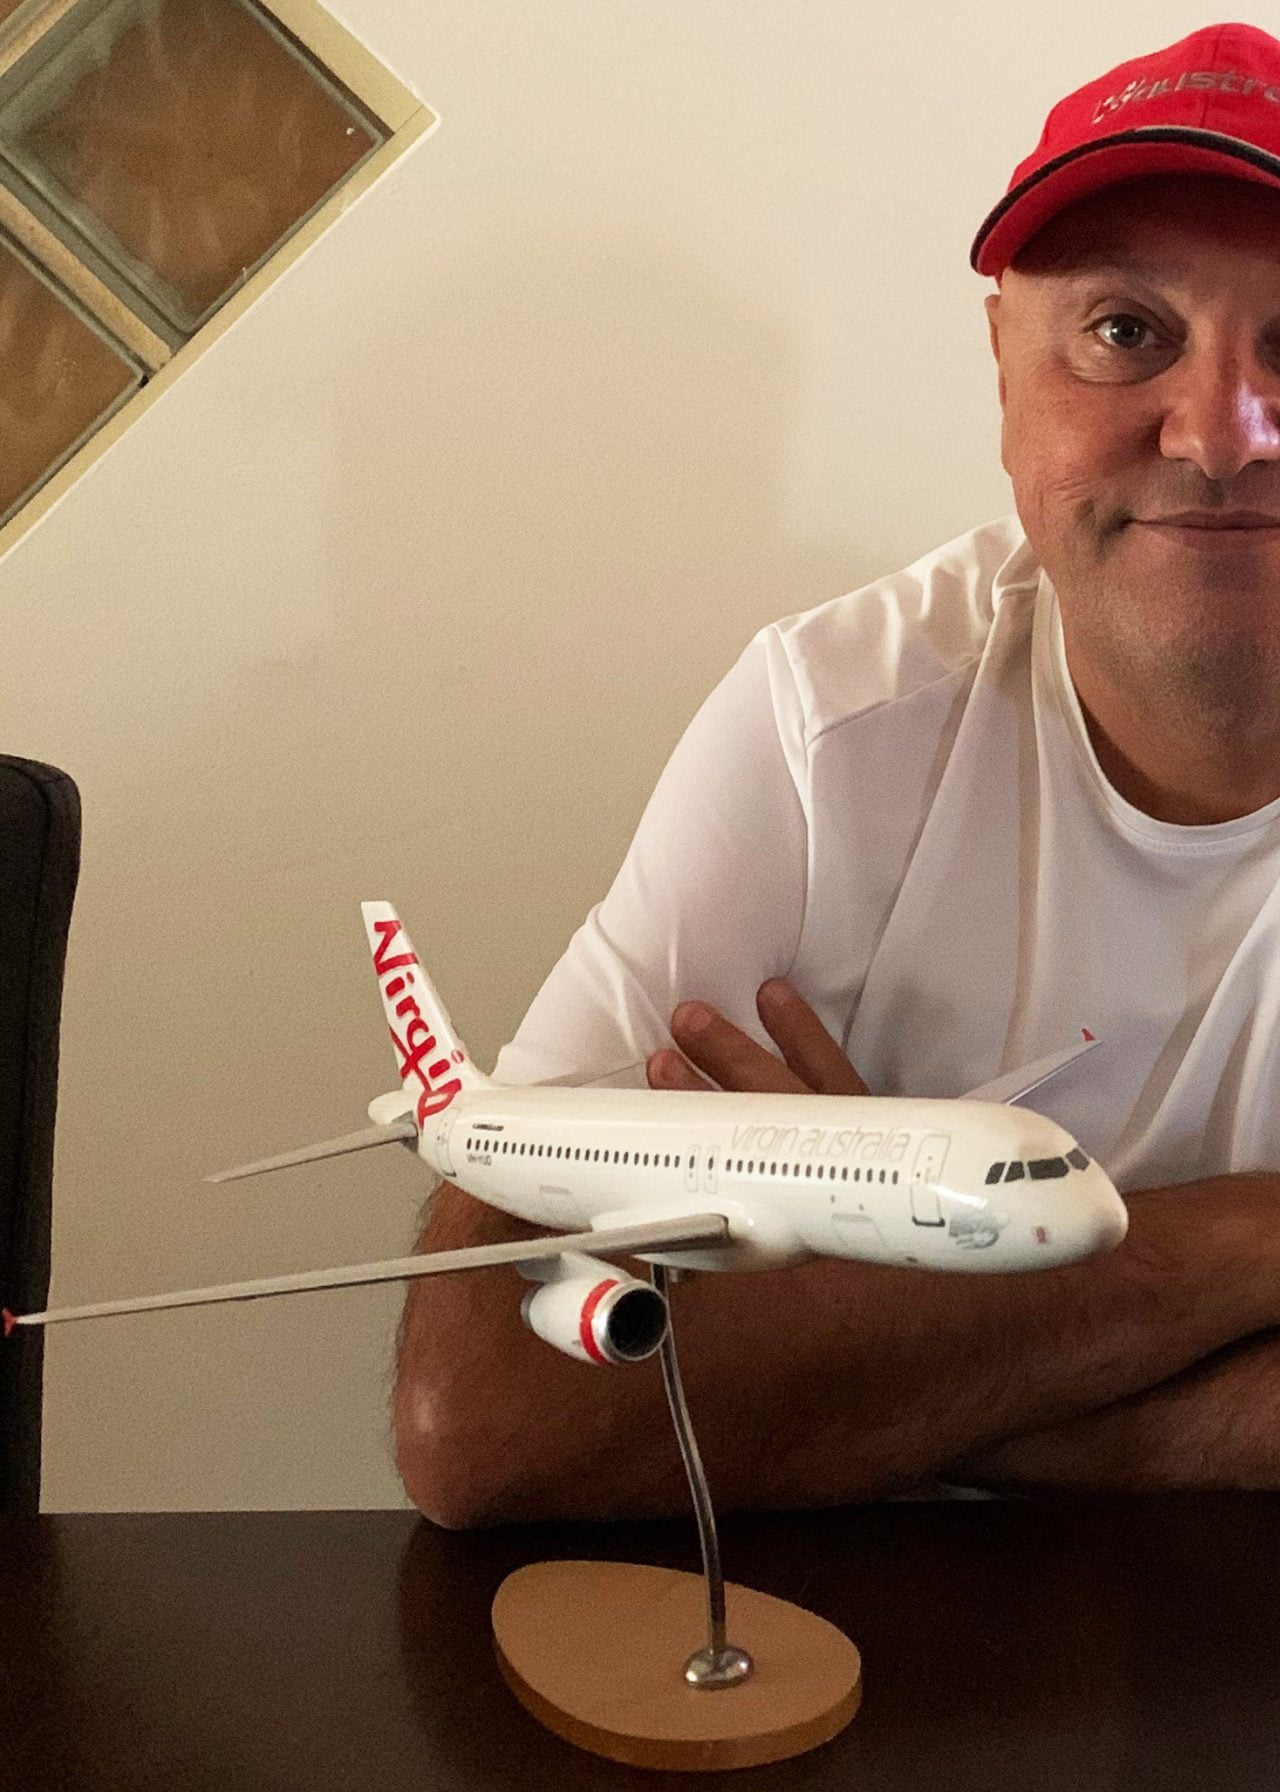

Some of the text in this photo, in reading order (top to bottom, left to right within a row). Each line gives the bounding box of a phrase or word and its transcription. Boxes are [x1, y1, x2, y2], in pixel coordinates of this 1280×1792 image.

[372, 919, 464, 1136] Virgin
[731, 1124, 912, 1163] virgin australia
